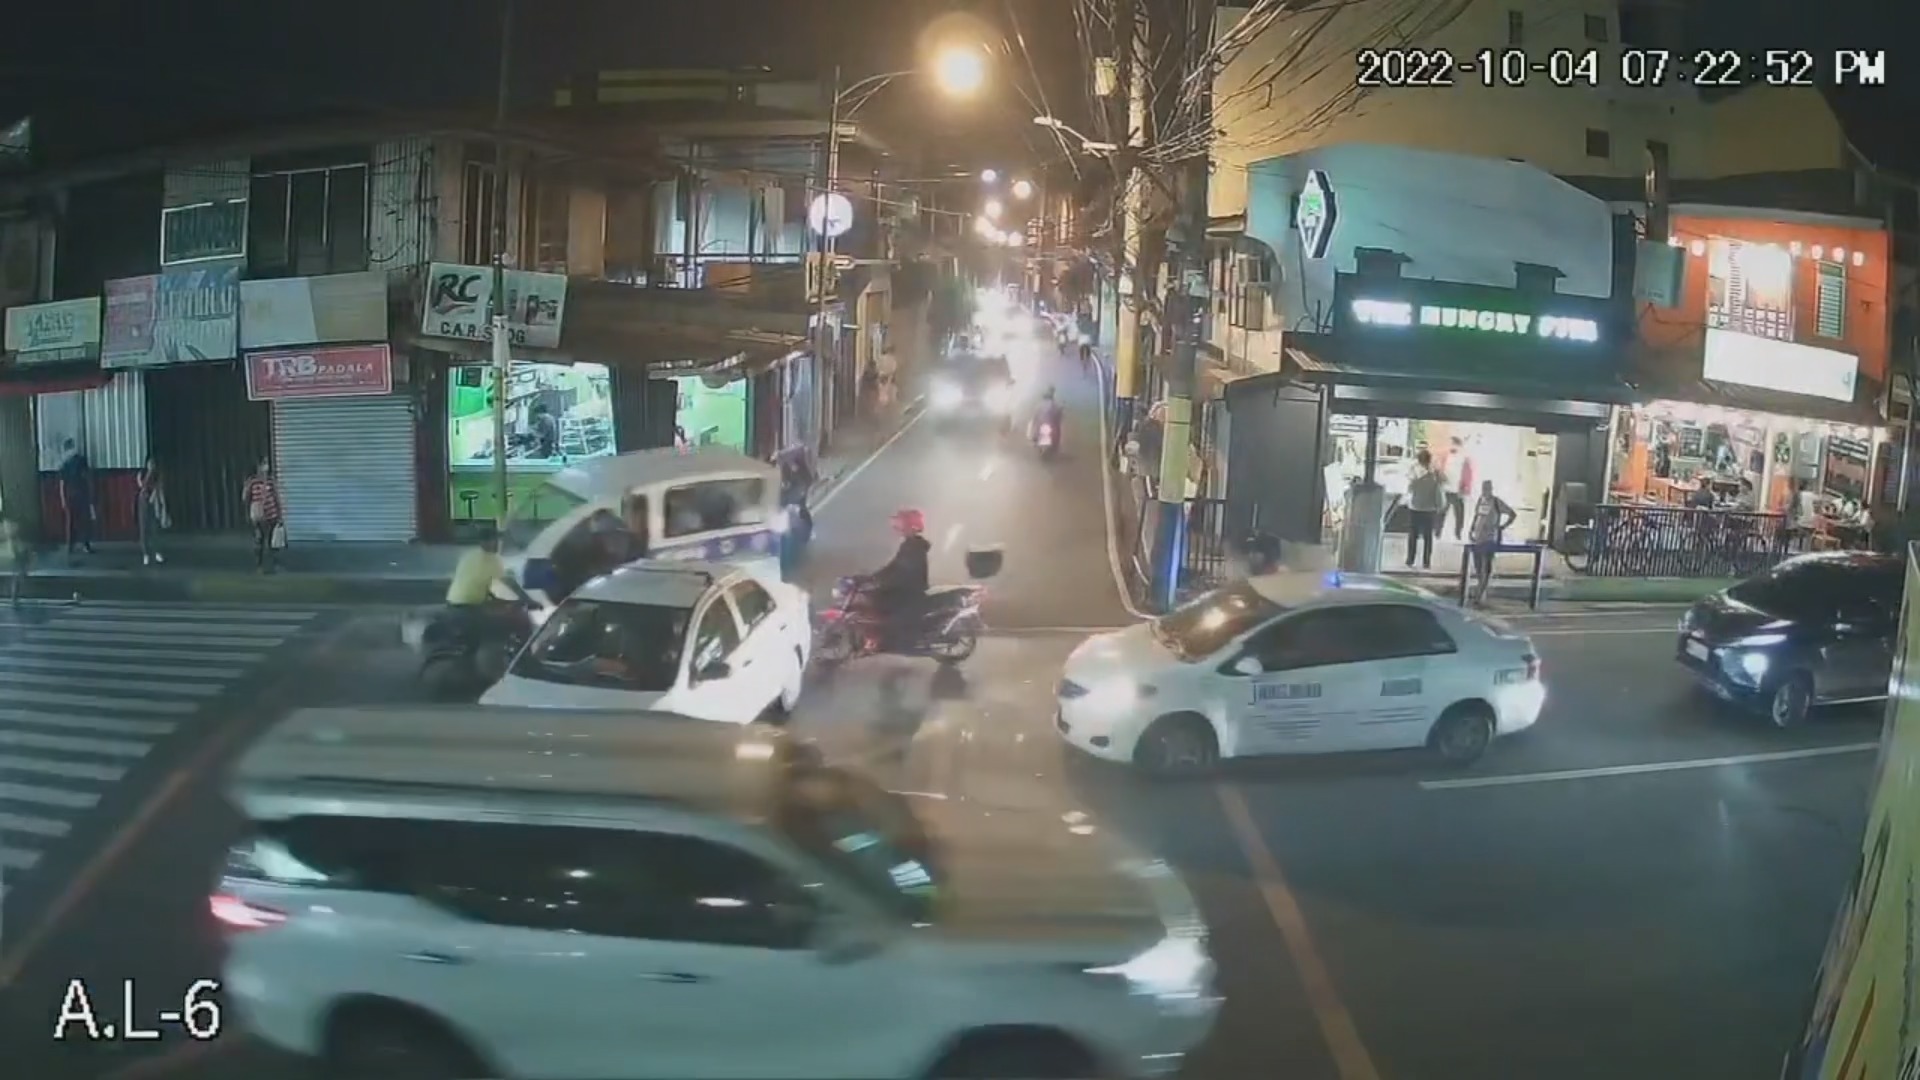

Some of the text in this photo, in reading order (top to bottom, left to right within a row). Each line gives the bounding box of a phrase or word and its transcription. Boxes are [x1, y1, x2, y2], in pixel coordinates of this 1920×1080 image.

[432, 273, 482, 308] RC
[440, 321, 477, 338] CAR
[1420, 305, 1531, 335] HUNGRY
[262, 355, 316, 379] TRB
